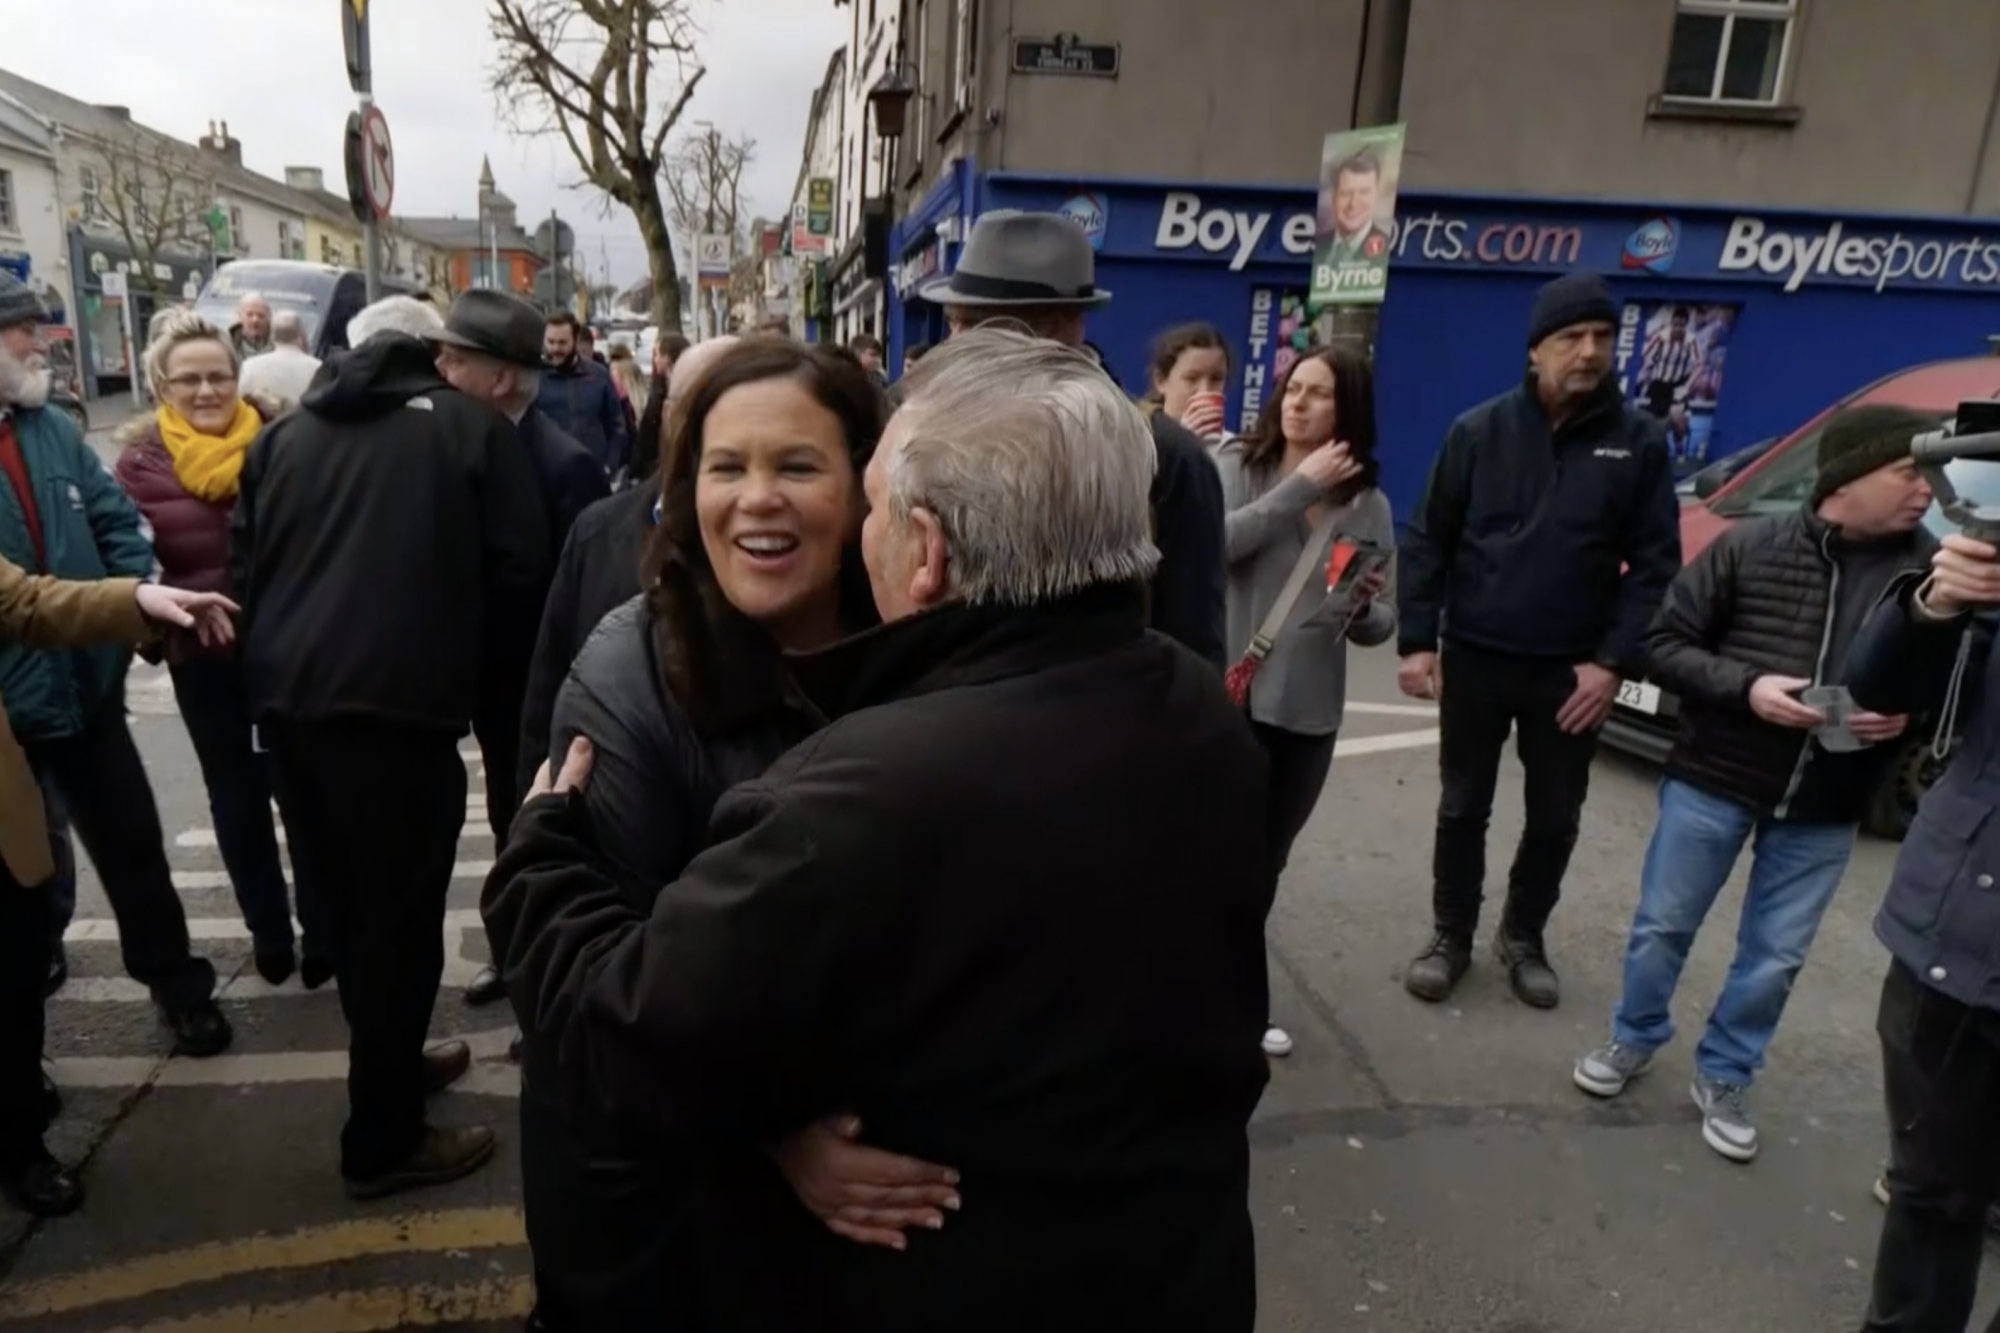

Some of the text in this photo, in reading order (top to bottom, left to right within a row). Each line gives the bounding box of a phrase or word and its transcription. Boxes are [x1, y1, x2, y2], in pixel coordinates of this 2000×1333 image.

[1316, 264, 1384, 292] Byrne
[1718, 216, 2000, 293] Boylesports
[1248, 289, 1272, 359] BET
[1616, 304, 1641, 372] BET
